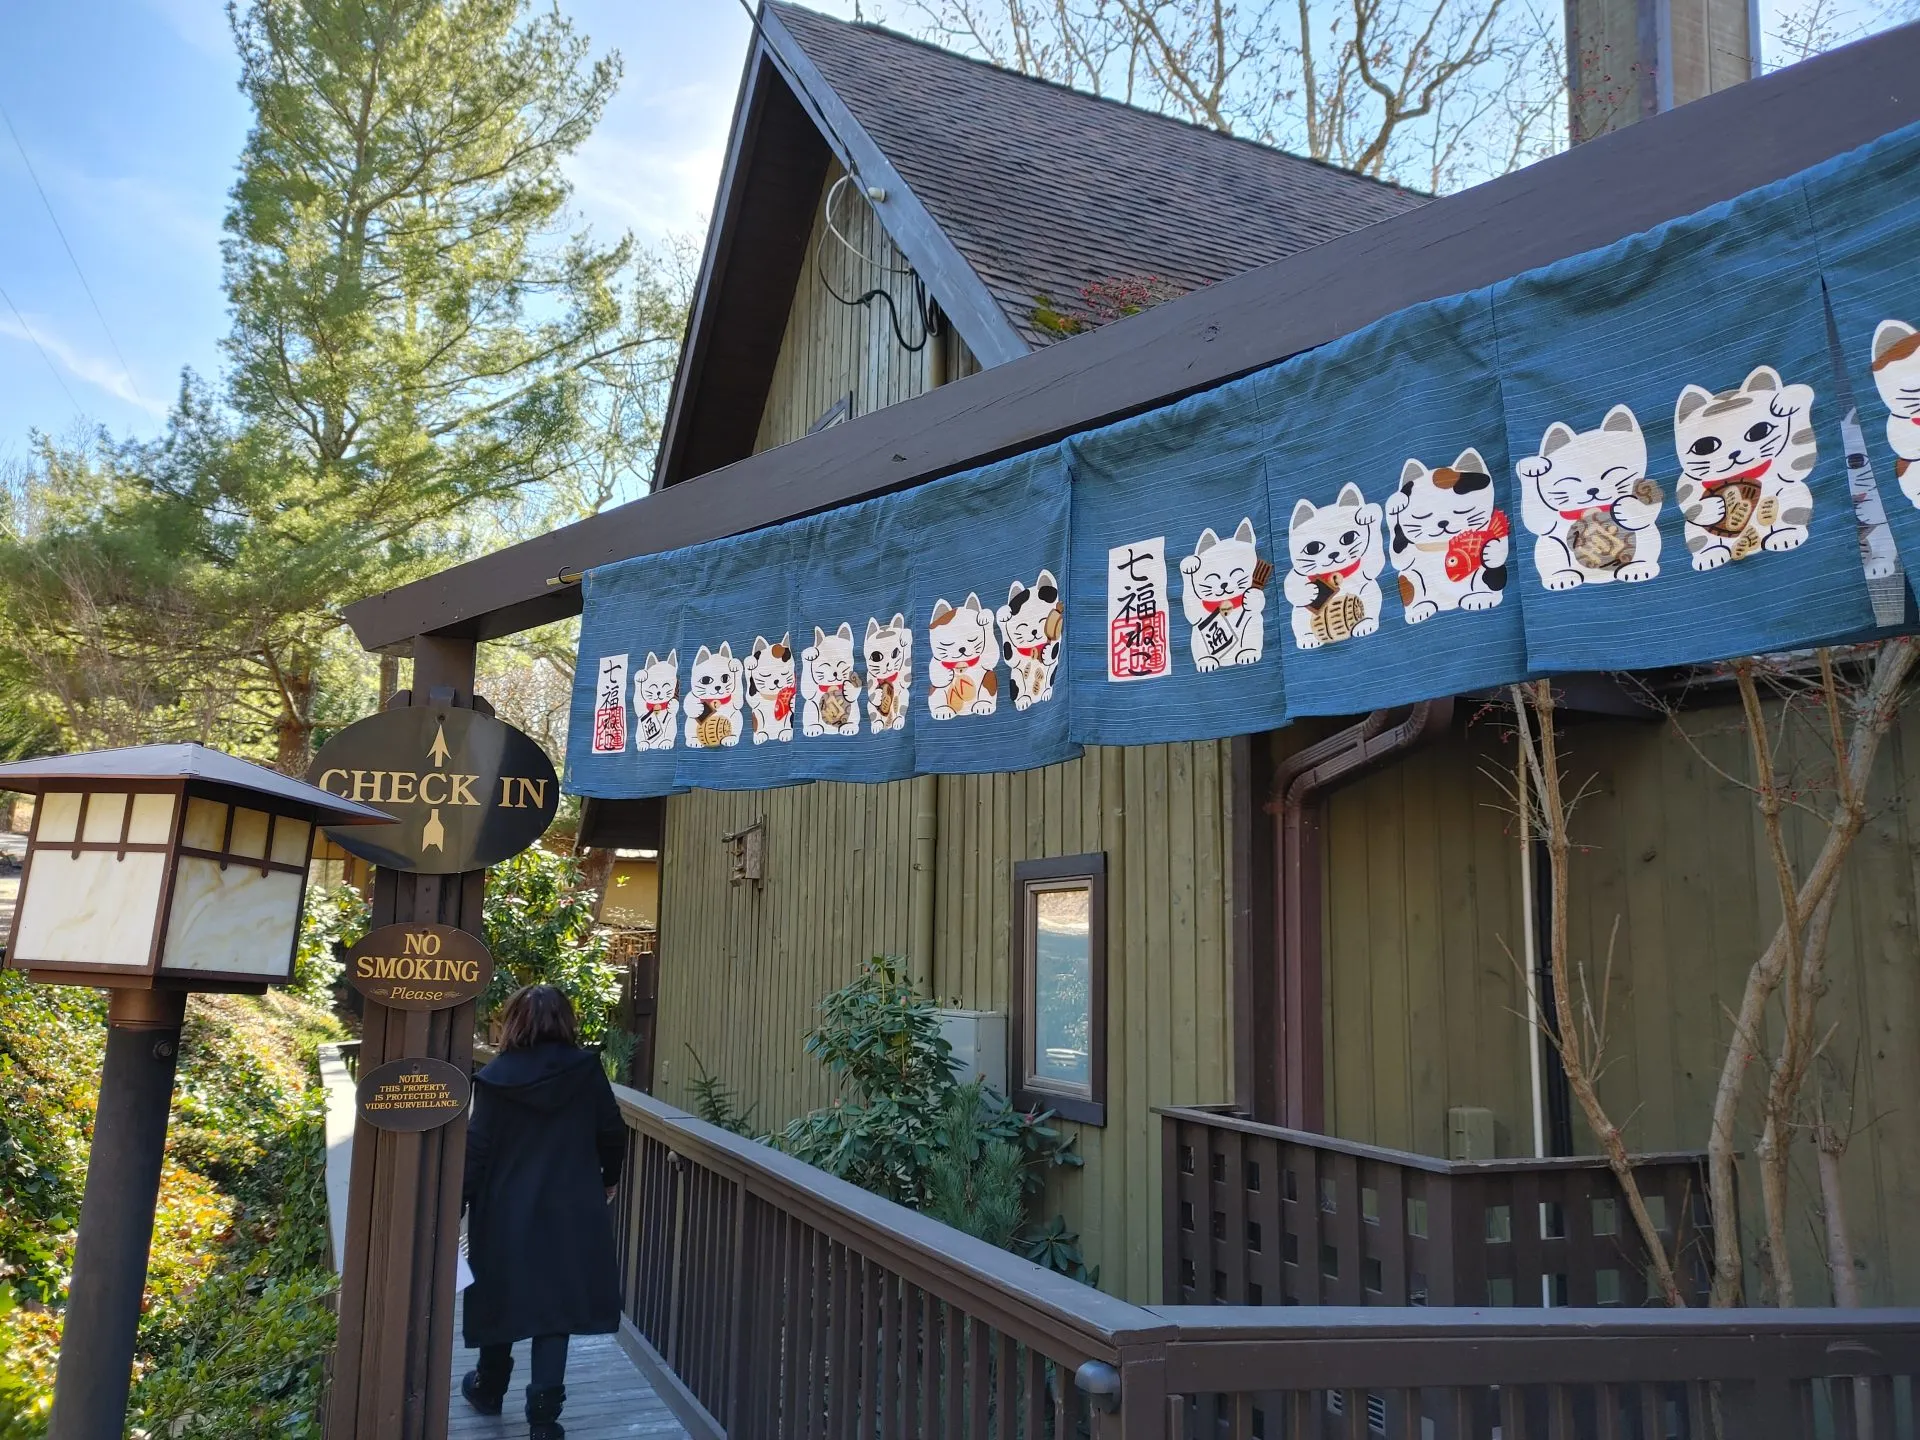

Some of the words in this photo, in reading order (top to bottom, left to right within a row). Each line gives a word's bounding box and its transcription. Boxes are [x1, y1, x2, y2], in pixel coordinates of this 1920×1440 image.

[318, 768, 481, 806] CHECK
[497, 776, 549, 809] IN
[402, 933, 441, 956] NO
[356, 956, 480, 982] SMOKING
[389, 986, 443, 1001] Please
[398, 1074, 429, 1084] NOTICE
[380, 1085, 401, 1093] THIS
[403, 1083, 447, 1092] PROPERTY
[375, 1094, 384, 1102] IS
[386, 1092, 437, 1101] PROTECTED
[439, 1091, 451, 1099] BY
[365, 1102, 392, 1110] VIDEO
[394, 1099, 459, 1109] SURVEILLANCE.
